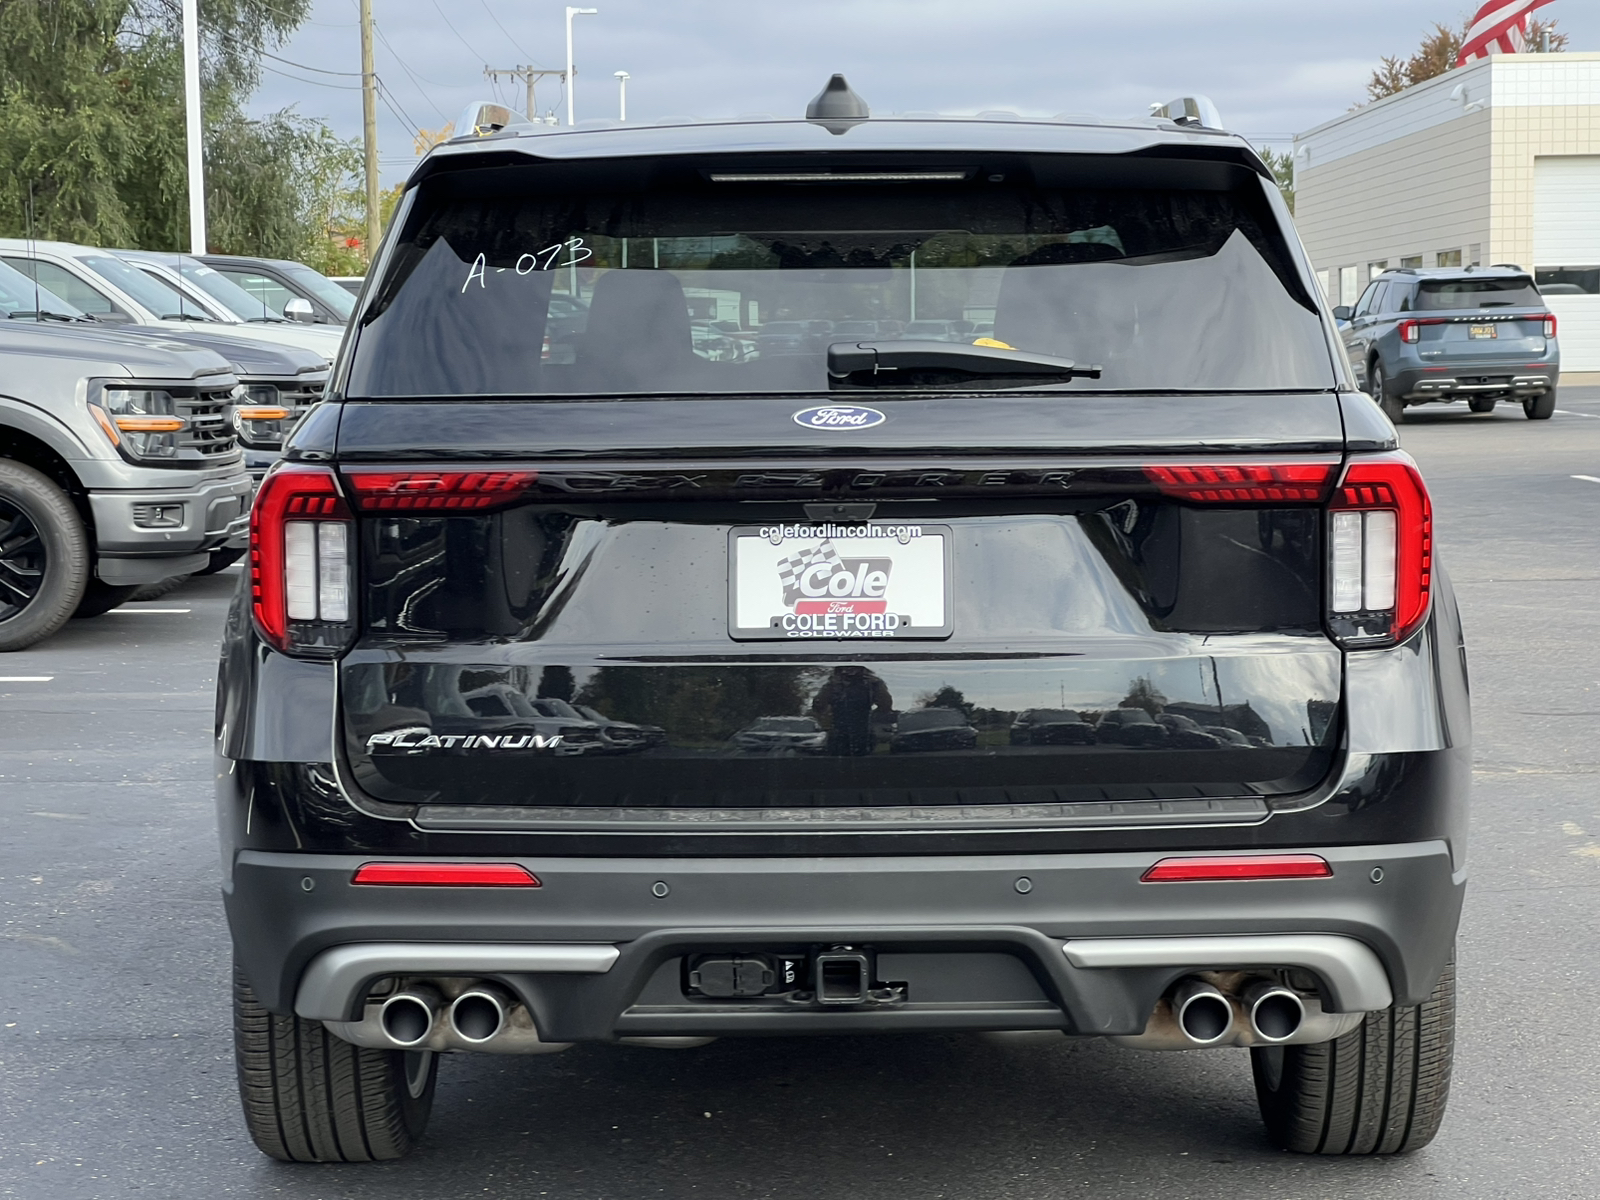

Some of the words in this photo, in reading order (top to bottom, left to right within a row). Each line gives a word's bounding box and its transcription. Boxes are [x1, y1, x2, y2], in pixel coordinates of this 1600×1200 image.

[810, 408, 868, 425] Ford
[609, 471, 1074, 488] EXPLORER
[759, 523, 922, 538] colefordlincoln.com
[799, 561, 888, 597] Cole
[827, 601, 854, 613] Ford
[782, 613, 837, 631] COLE
[843, 613, 899, 630] FORD
[366, 733, 564, 749] PLATINUM
